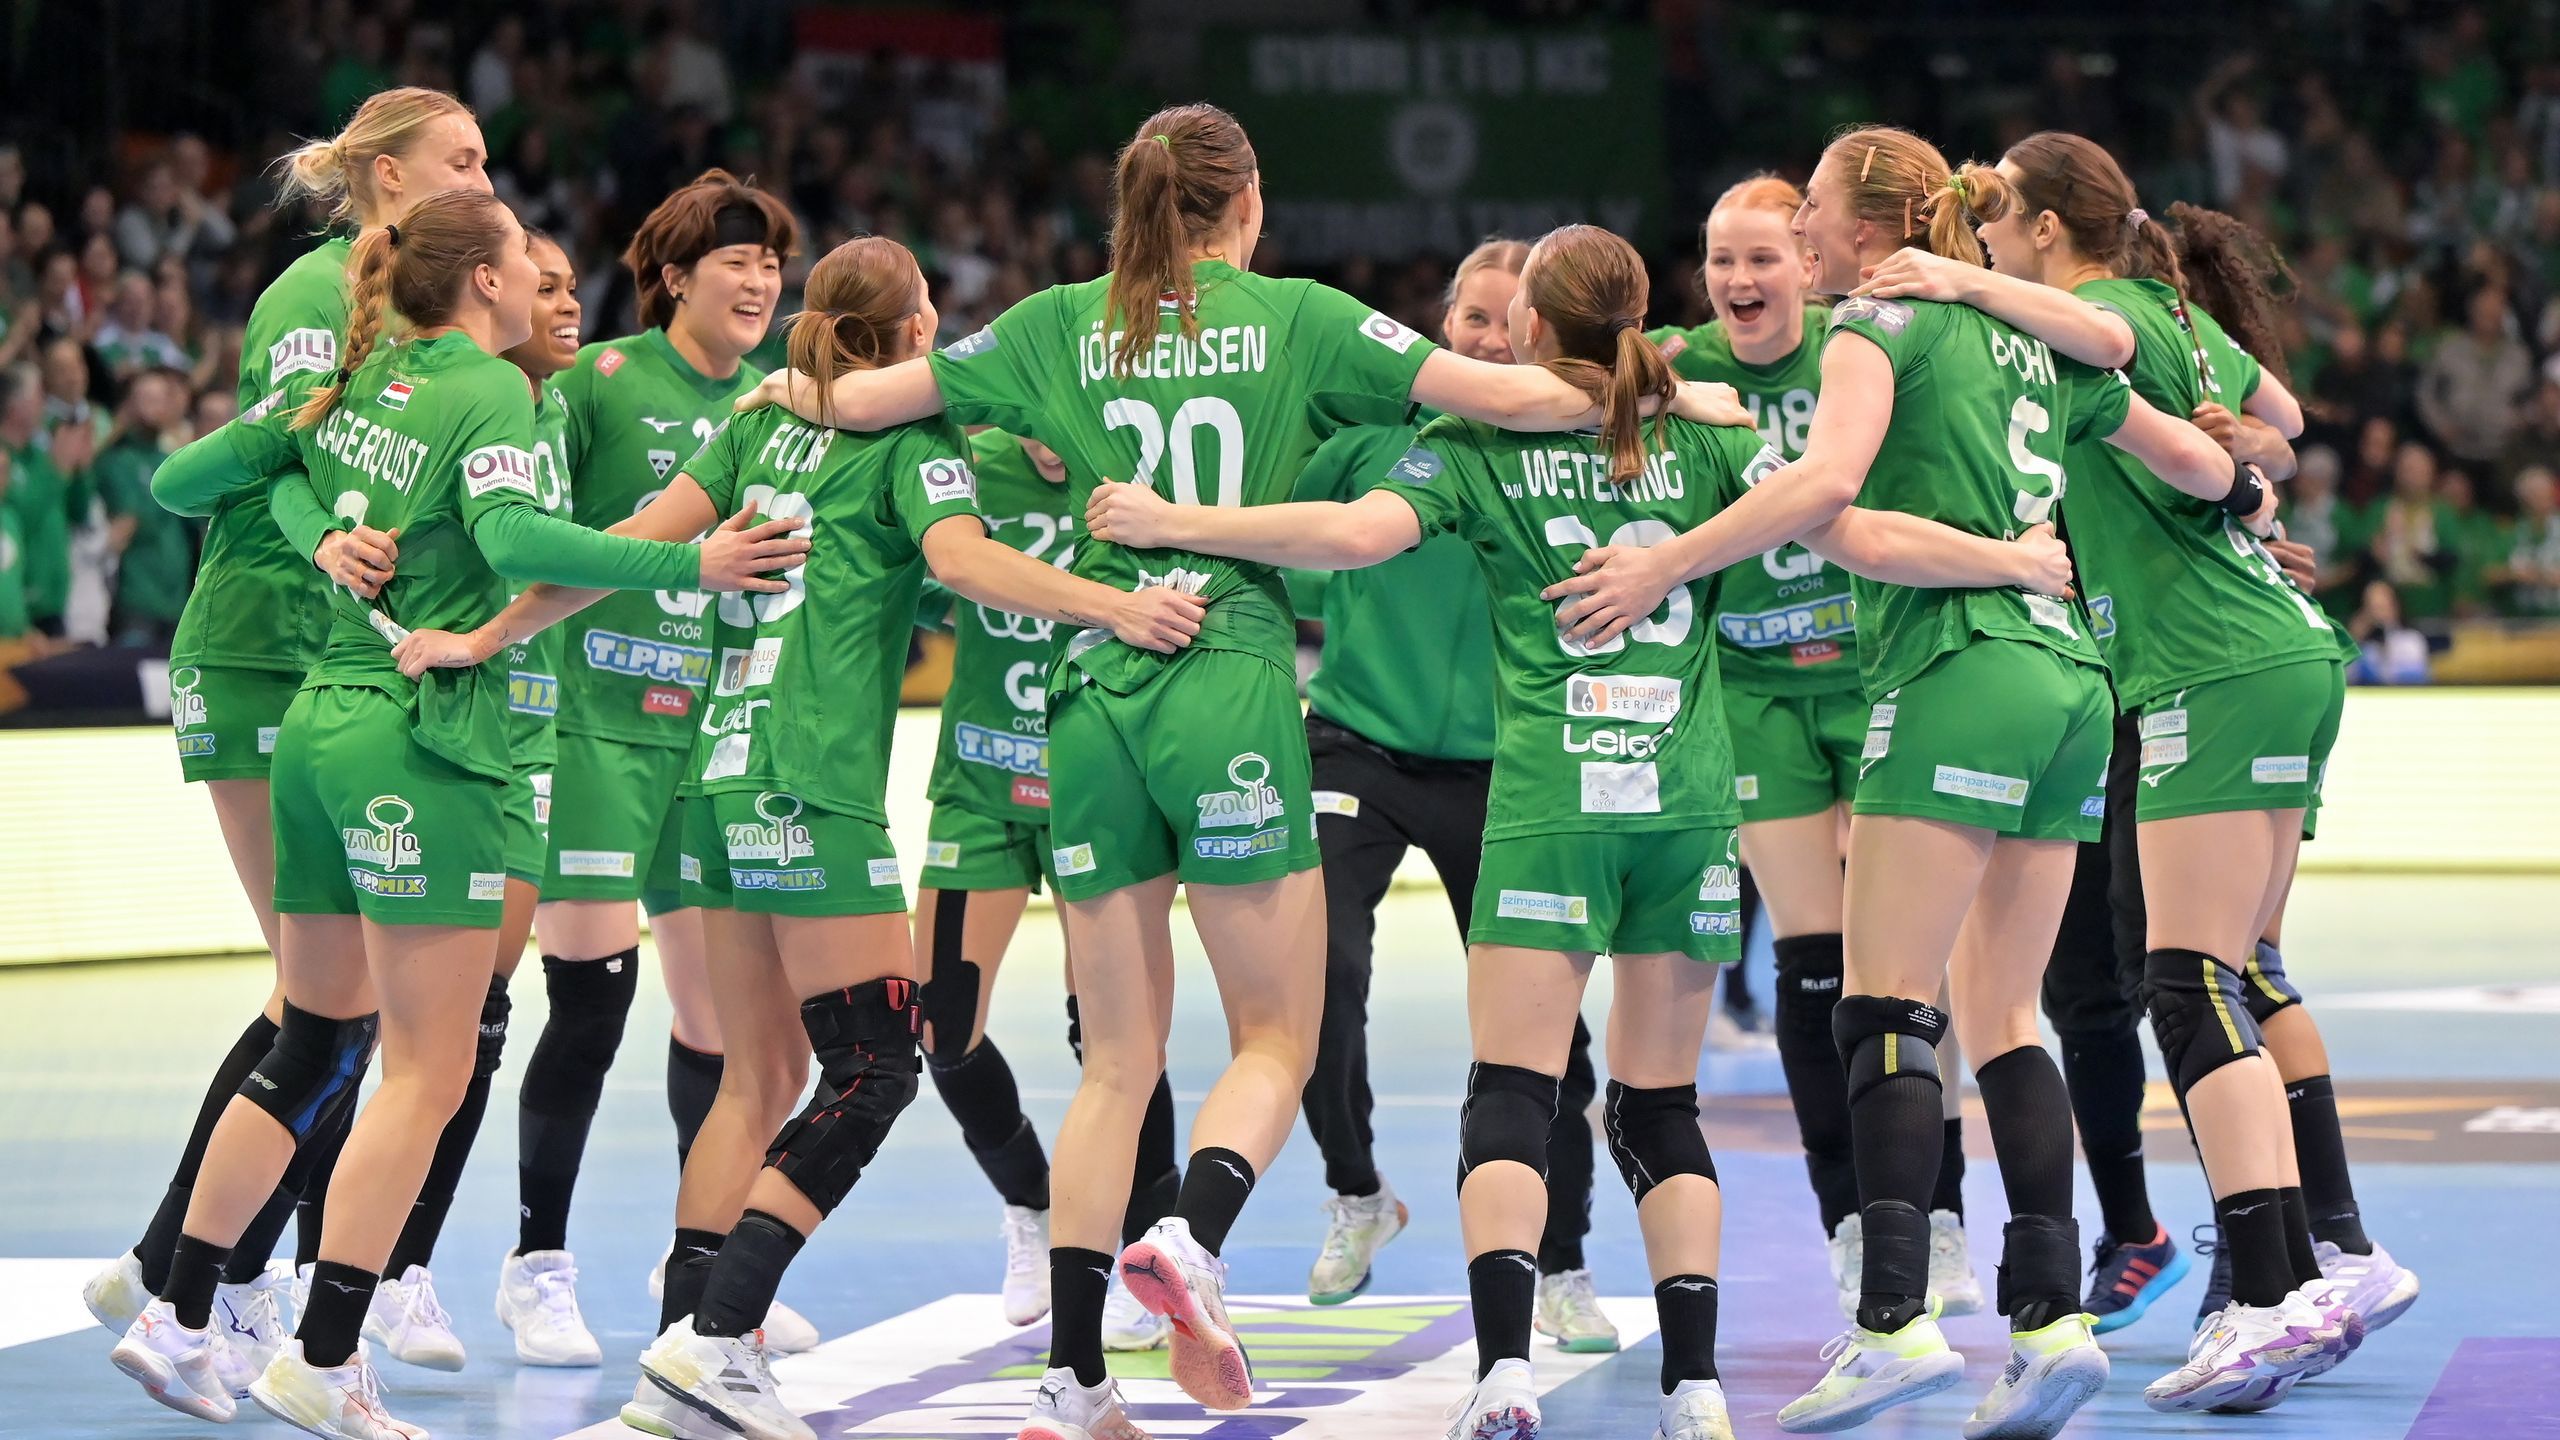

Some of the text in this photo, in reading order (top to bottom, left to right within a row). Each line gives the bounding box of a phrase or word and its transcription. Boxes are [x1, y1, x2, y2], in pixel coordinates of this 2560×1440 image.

[274, 333, 332, 368] OIL!
[1748, 388, 1816, 454] 48
[1103, 396, 1245, 508] 20
[2007, 395, 2062, 524] 5
[468, 450, 531, 483] OIL!
[659, 621, 702, 640] GYŐR
[651, 692, 683, 708] TCL
[1611, 686, 1676, 703] ENDO PLUS
[1611, 700, 1676, 714] SERVICE
[701, 700, 771, 737] Leier
[1563, 723, 1674, 759] Leier
[1938, 770, 2007, 792] szimpatika
[1502, 894, 1567, 911] szimpatika
[1801, 978, 1839, 990] SELECT
